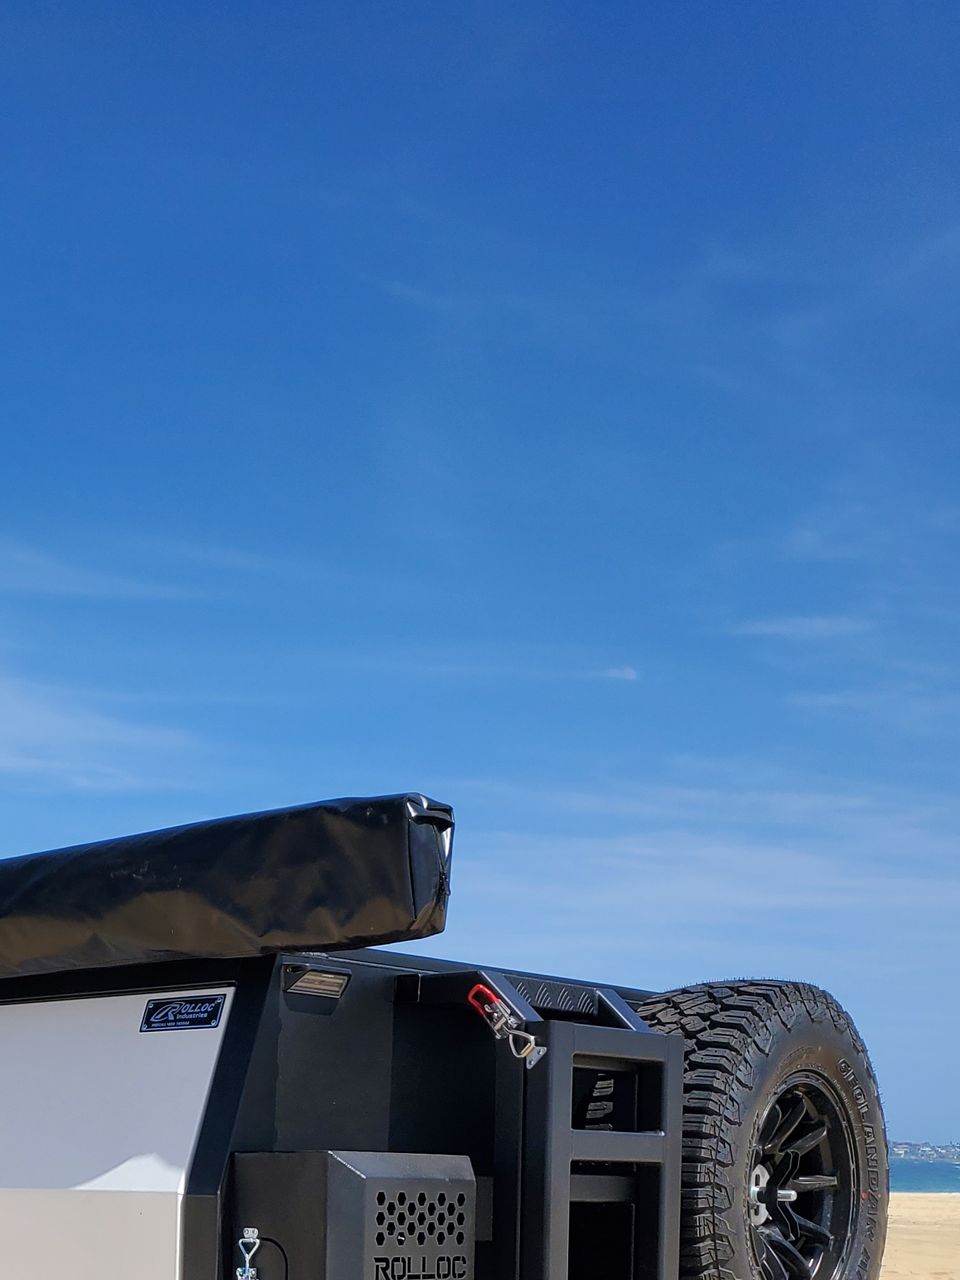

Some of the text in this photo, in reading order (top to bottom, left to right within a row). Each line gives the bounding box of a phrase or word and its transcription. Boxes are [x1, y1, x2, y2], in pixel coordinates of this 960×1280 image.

[150, 1002, 216, 1022] ROLLOC
[177, 1012, 208, 1020] Industries
[373, 1255, 467, 1280] ROLLOC
